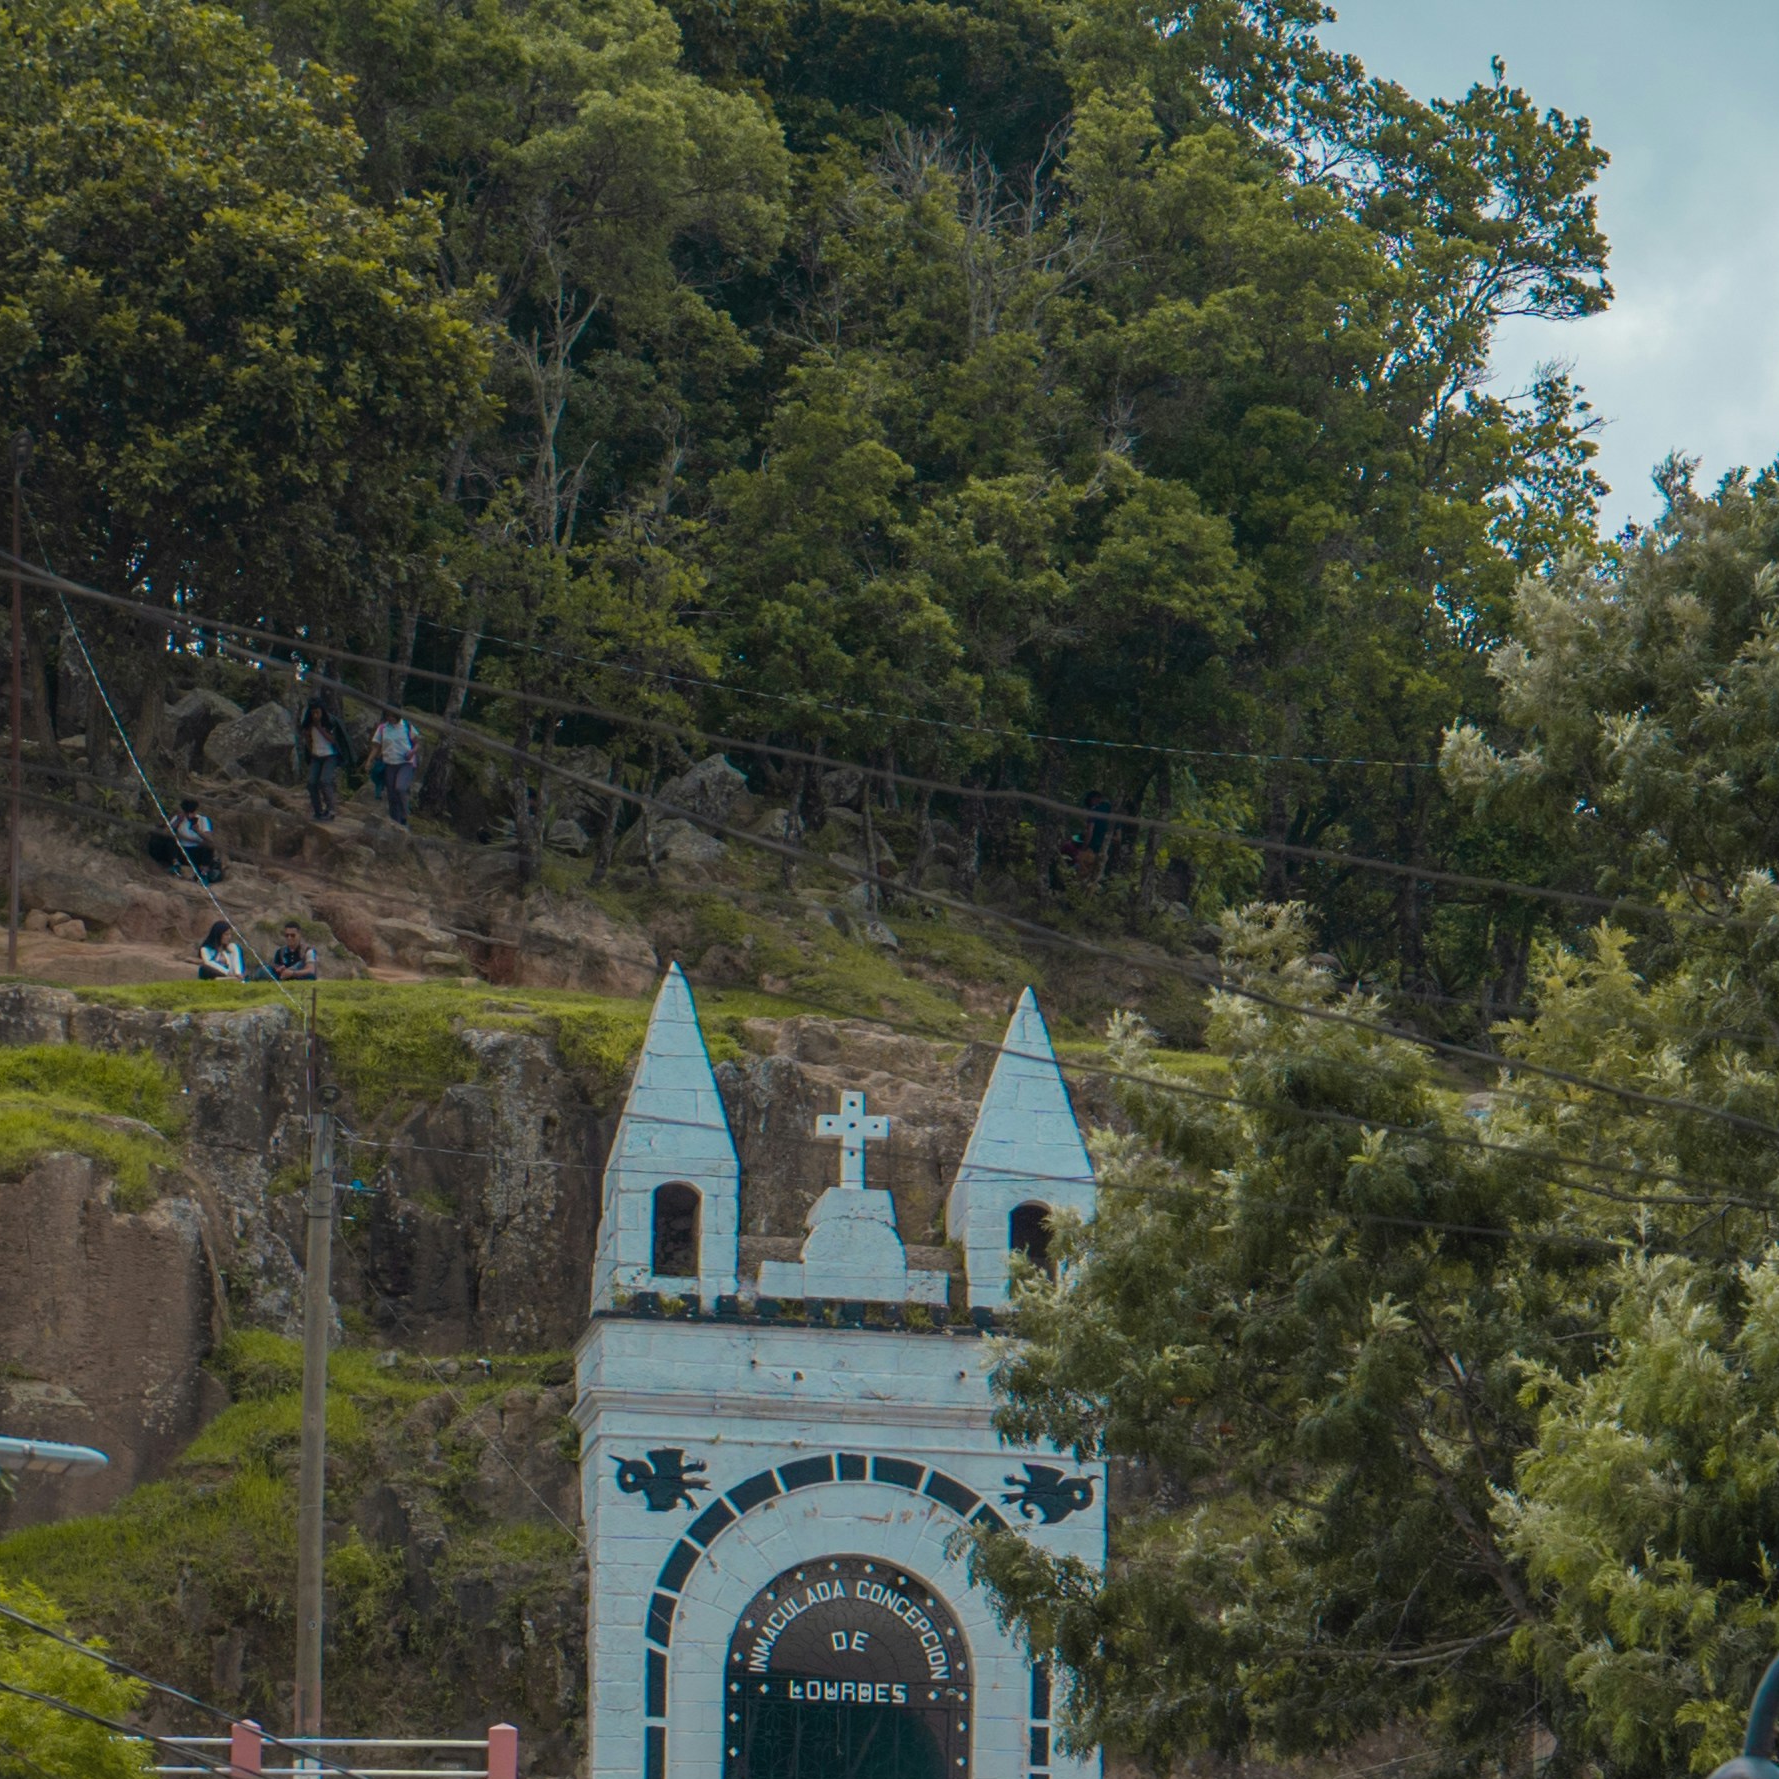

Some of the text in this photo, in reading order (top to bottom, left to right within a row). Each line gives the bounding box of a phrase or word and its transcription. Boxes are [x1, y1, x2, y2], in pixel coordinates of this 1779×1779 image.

[748, 1578, 950, 1680] INMACULADA CONCEPCION
[831, 1630, 870, 1652] DE
[789, 1679, 907, 1704] LOURDES
